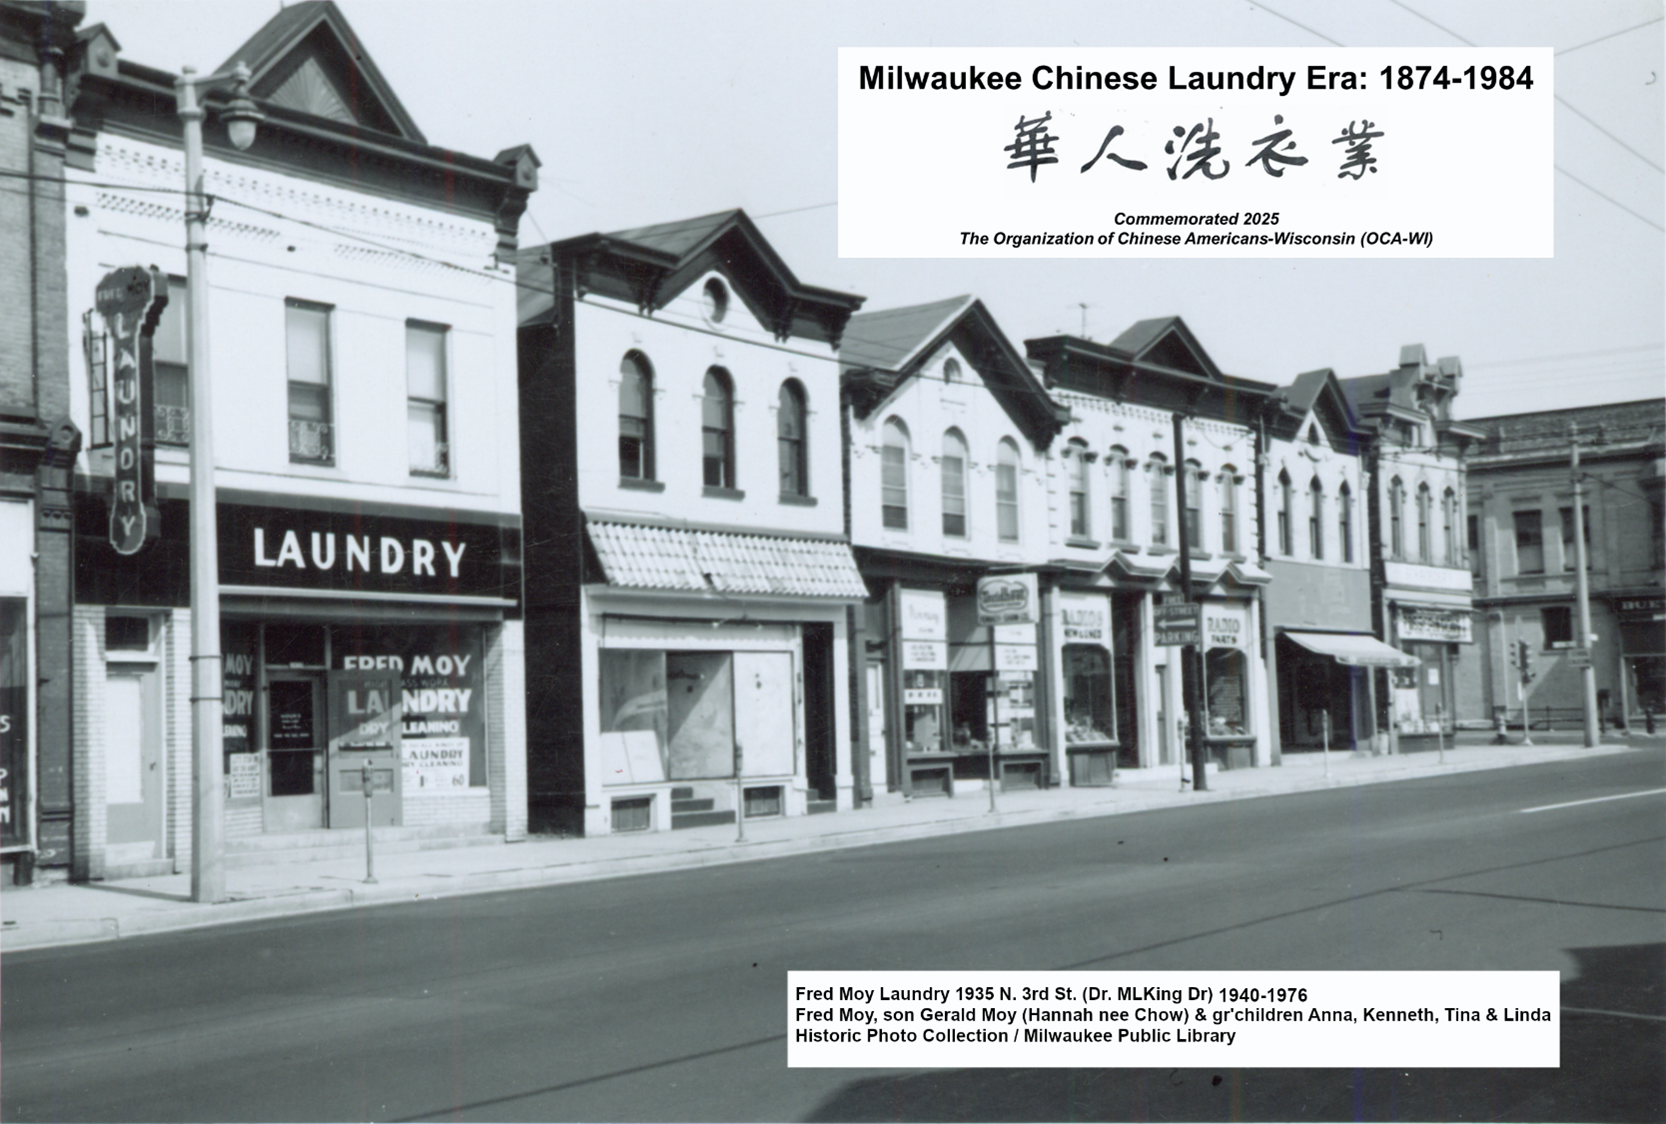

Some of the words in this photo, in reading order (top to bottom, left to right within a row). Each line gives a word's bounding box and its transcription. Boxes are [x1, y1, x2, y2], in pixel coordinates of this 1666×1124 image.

[115, 312, 137, 537] LAUNDRY
[253, 527, 467, 578] LAUNDRY
[1207, 617, 1241, 634] RADIO
[411, 654, 471, 676] MOY
[360, 722, 390, 736] DRY
